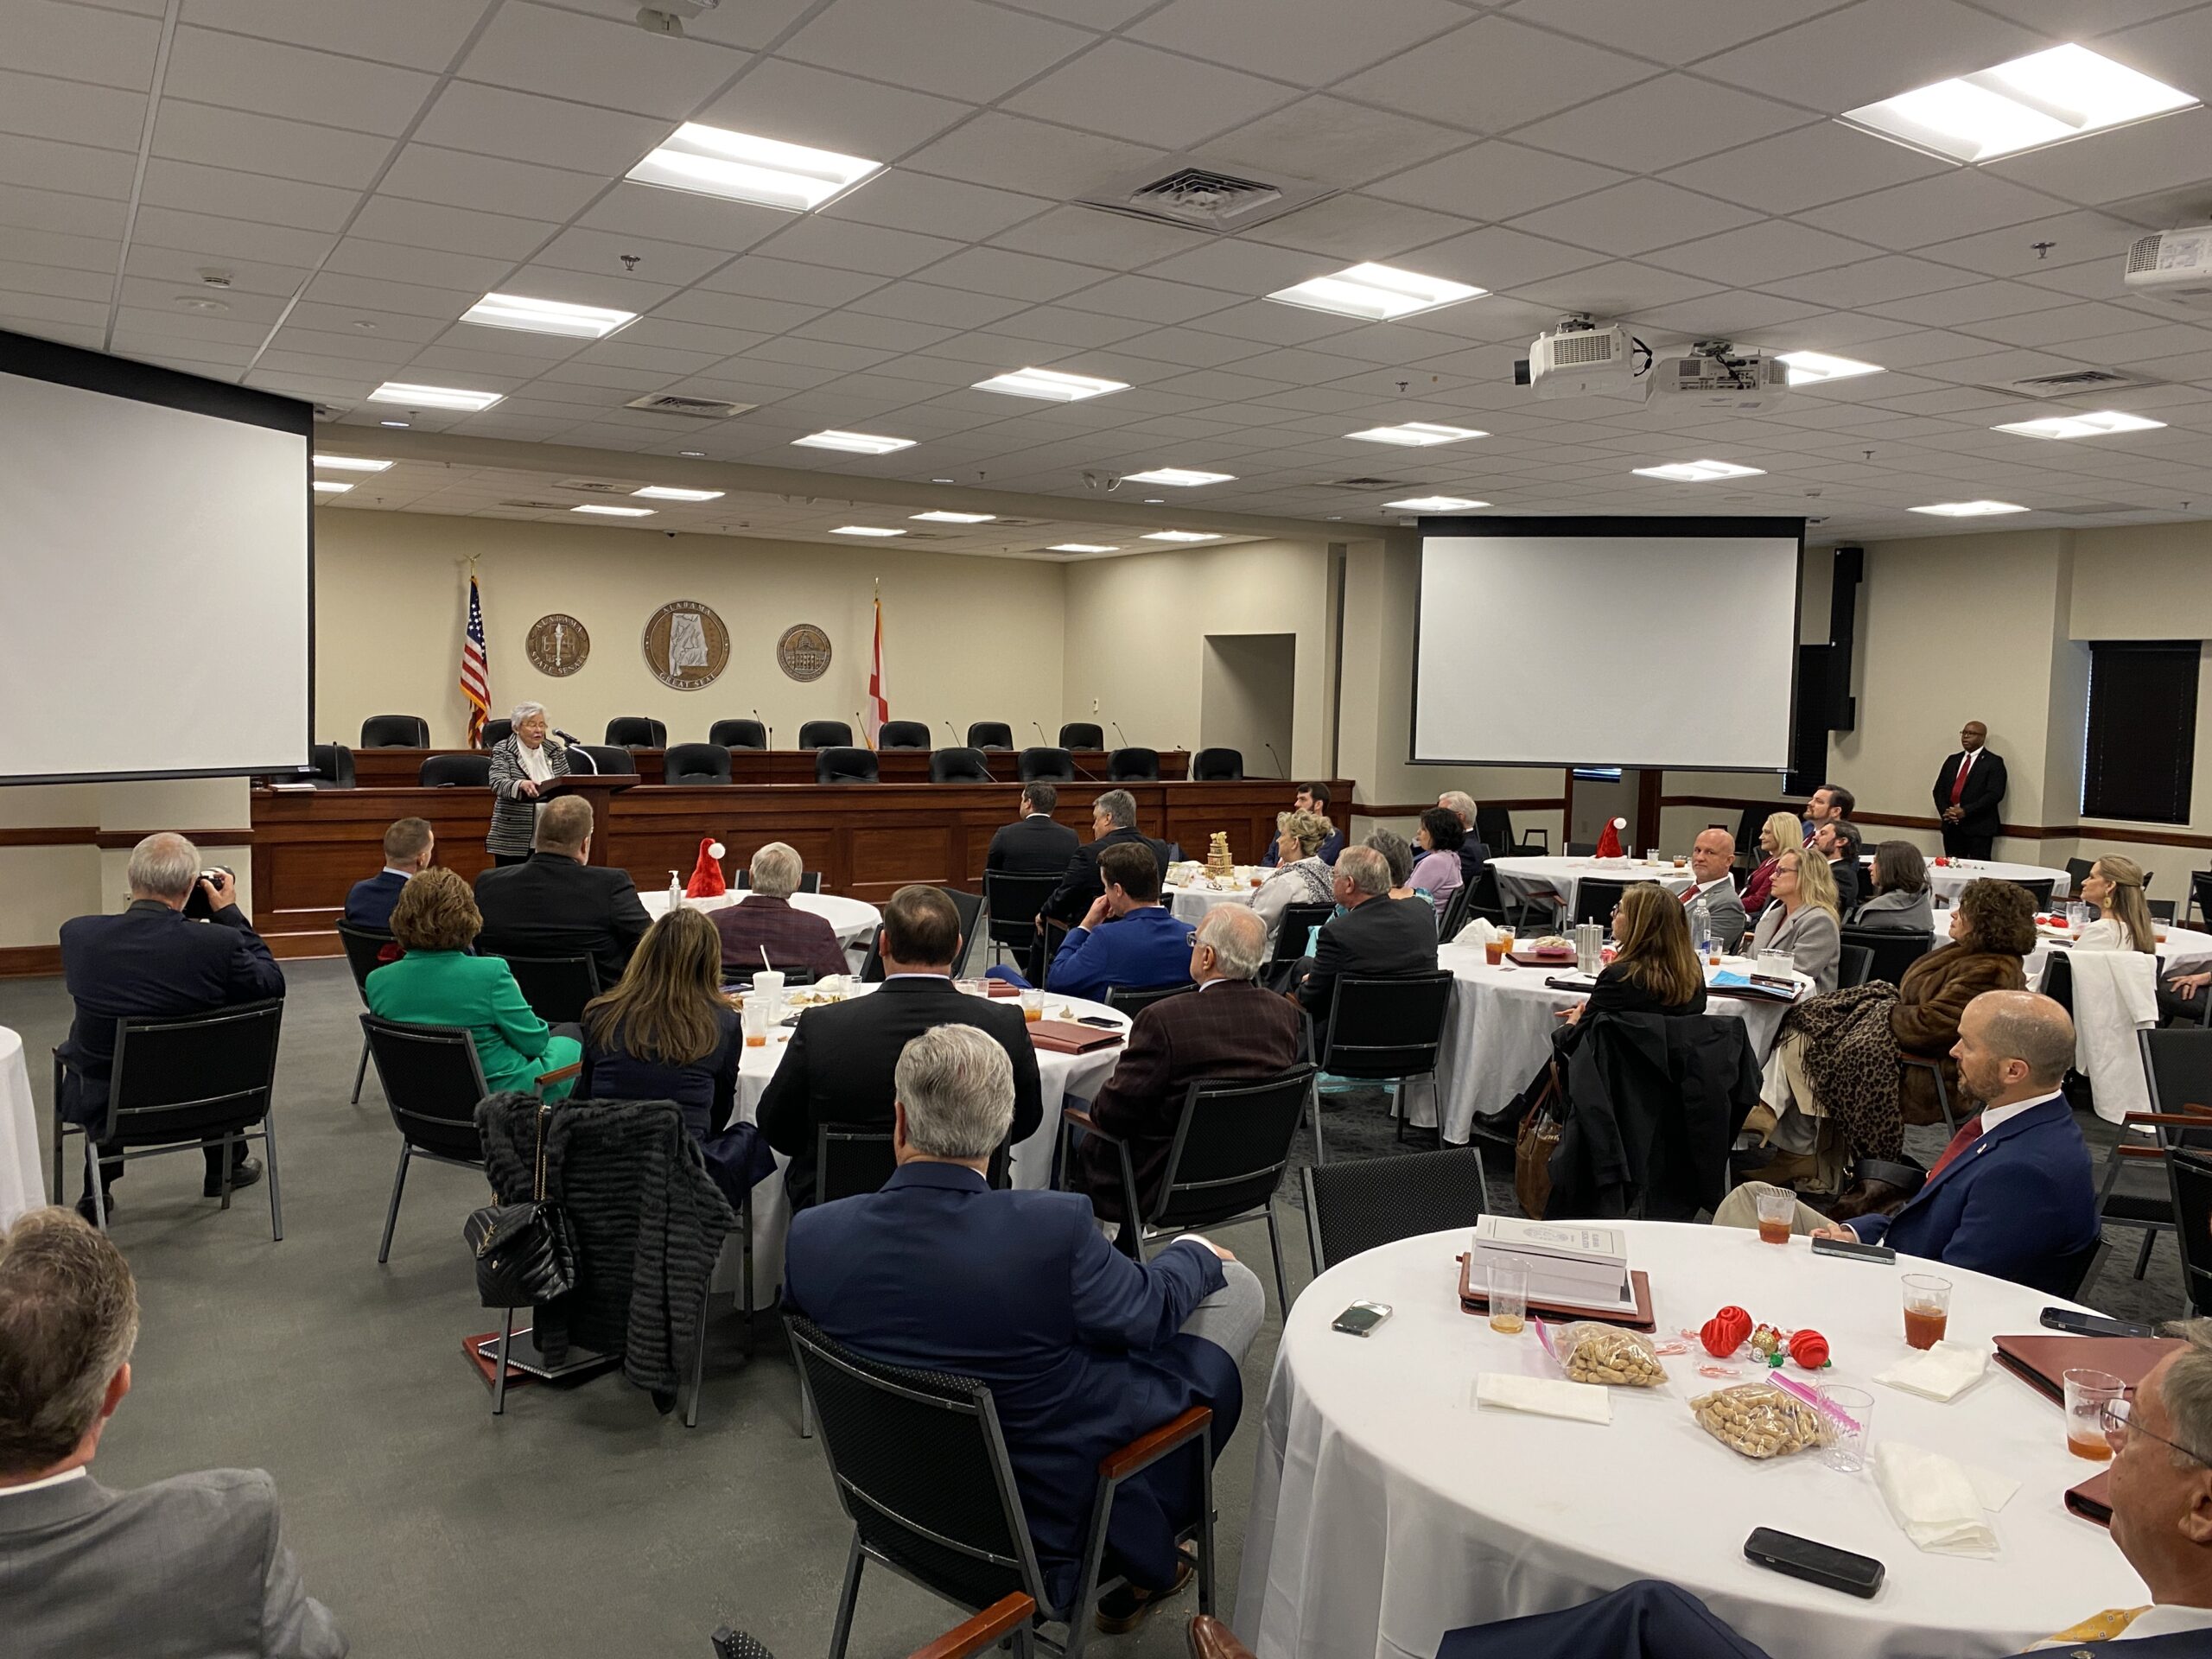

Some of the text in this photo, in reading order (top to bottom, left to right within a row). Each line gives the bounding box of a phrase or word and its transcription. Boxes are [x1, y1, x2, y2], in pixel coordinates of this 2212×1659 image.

[663, 602, 710, 614] ALABAMA
[536, 615, 582, 632] ALABAMA
[531, 651, 586, 674] STATE SENATE
[659, 672, 715, 688] GREAT SEAL
